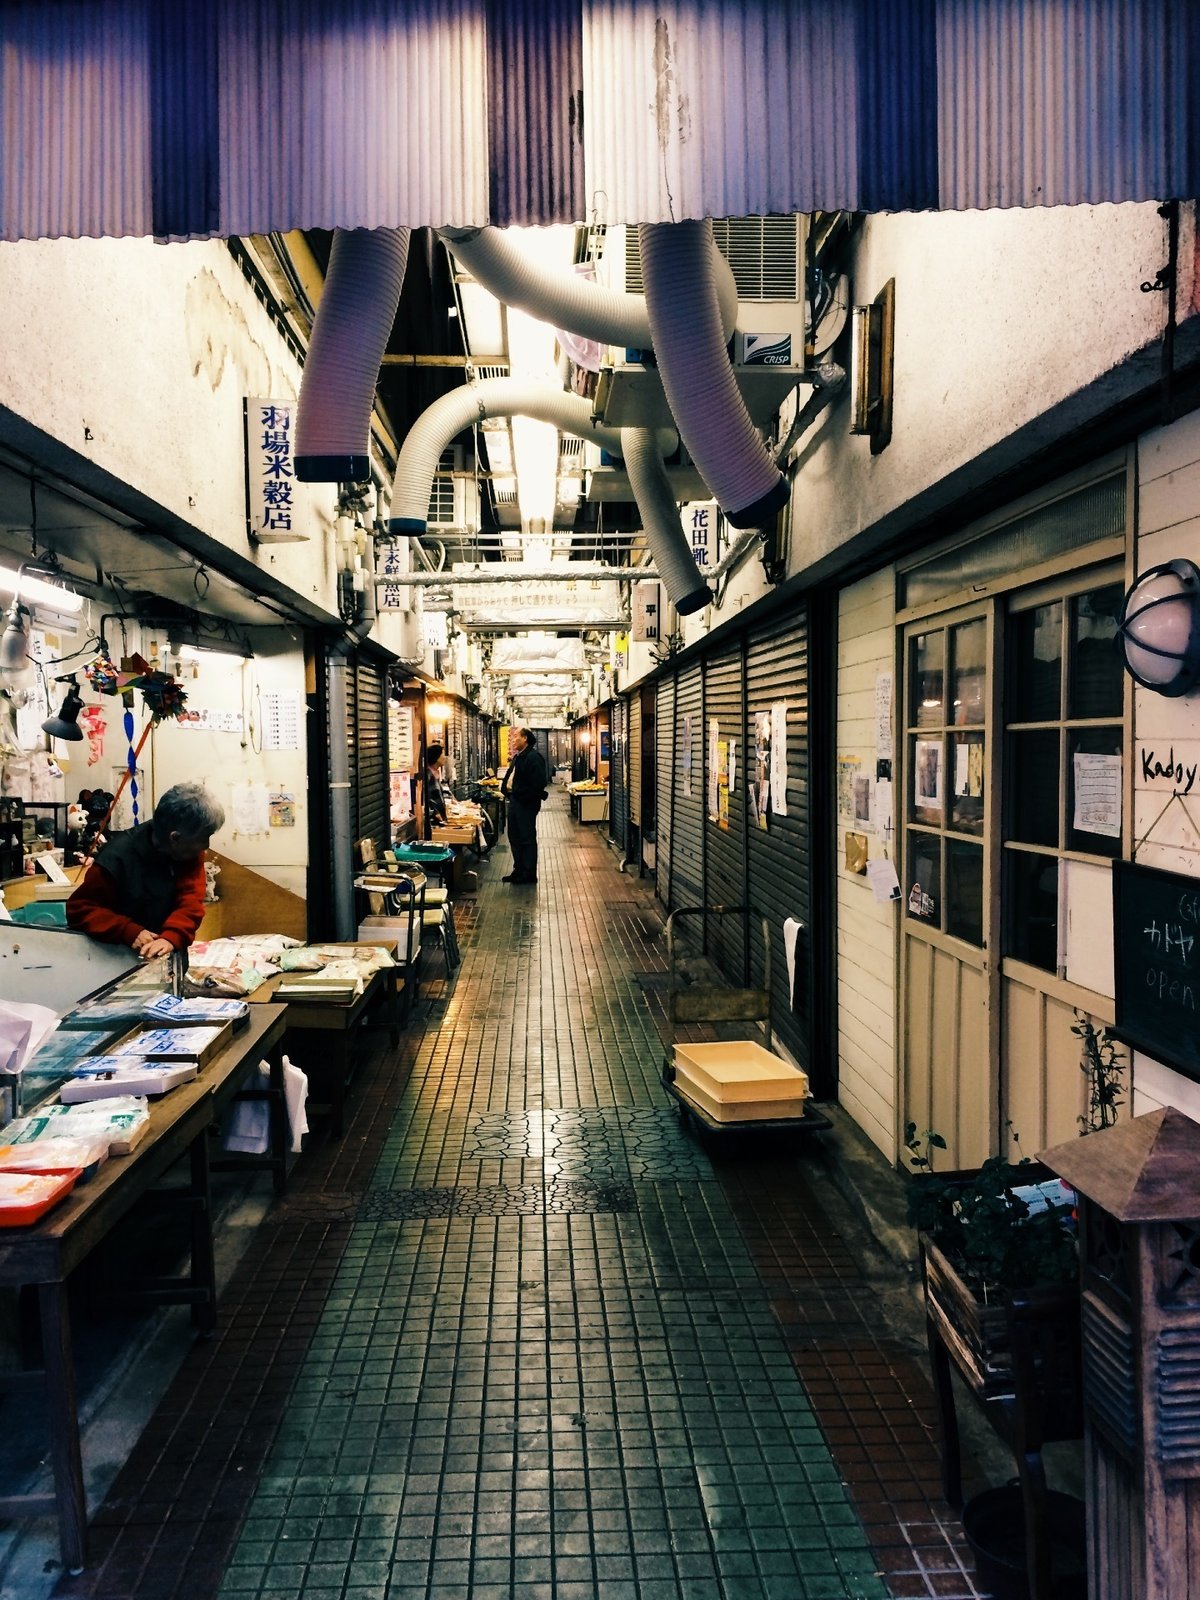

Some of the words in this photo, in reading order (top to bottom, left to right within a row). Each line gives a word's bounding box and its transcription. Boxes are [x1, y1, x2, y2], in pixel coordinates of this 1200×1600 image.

[763, 355, 789, 364] CRISP
[260, 405, 293, 531] 羽場米穀店
[645, 604, 656, 638] 平山
[1142, 745, 1200, 793] Kadoy
[1179, 894, 1200, 923] Caf
[1144, 920, 1194, 962] カドヤ
